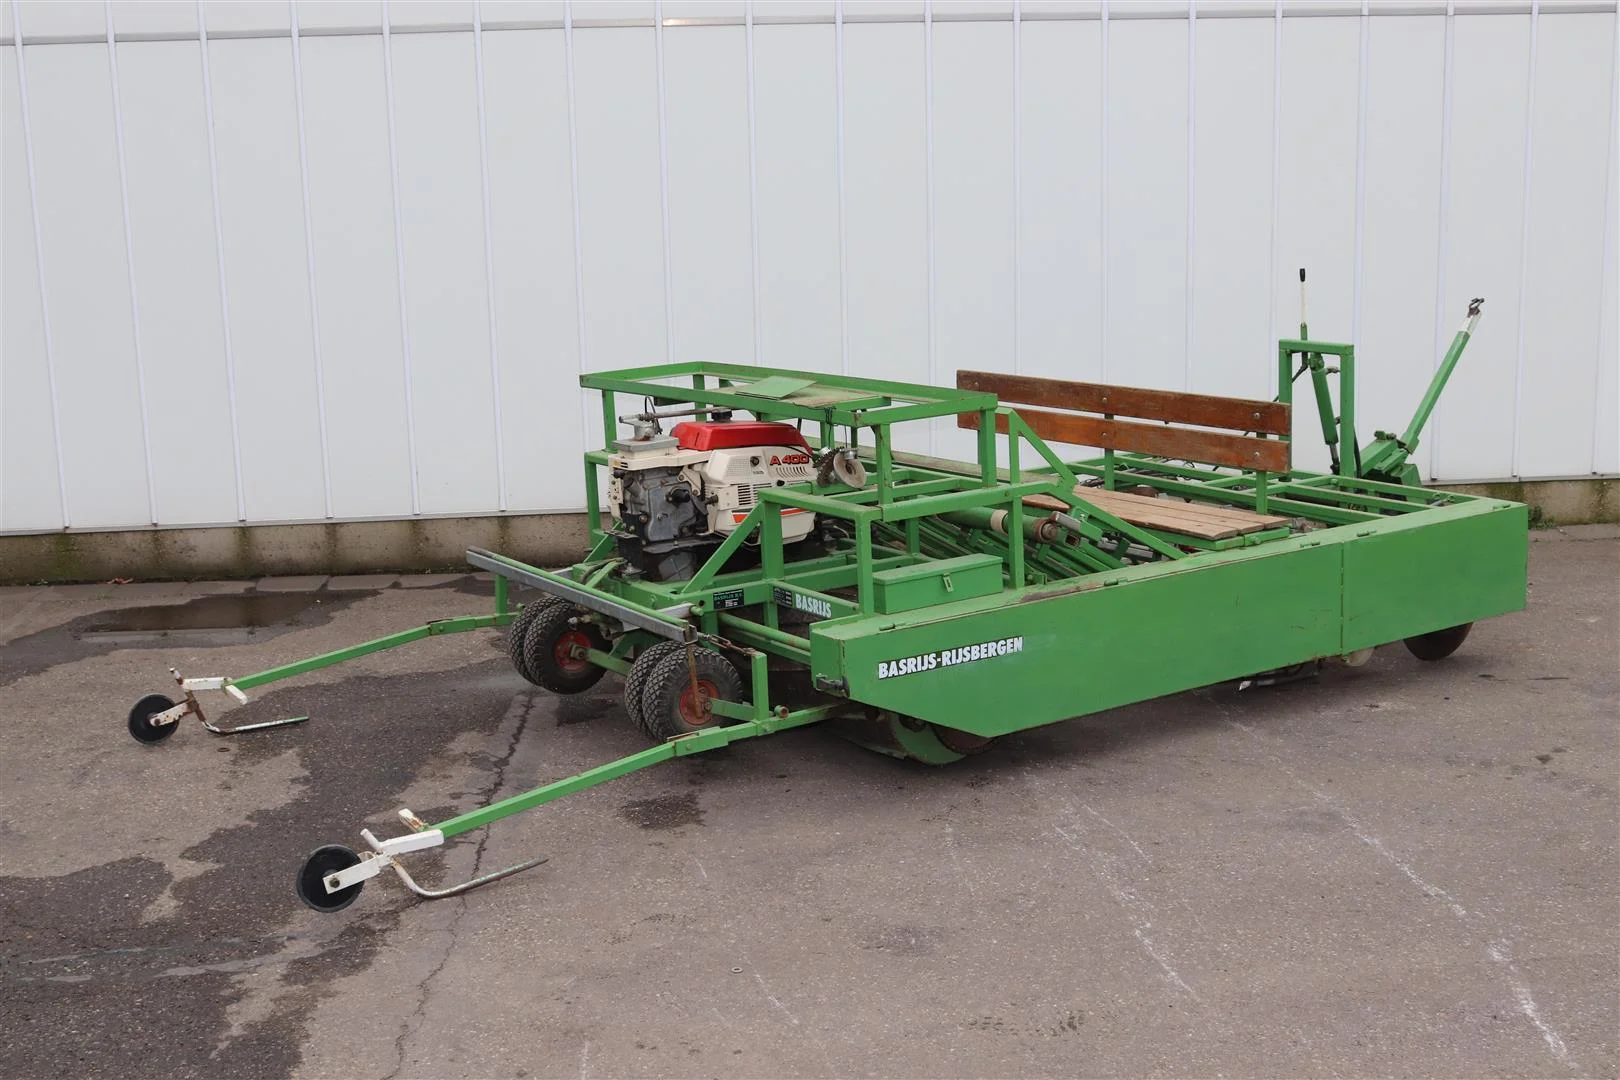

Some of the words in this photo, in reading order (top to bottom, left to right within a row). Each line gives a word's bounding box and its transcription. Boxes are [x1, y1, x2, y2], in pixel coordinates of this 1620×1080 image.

[770, 456, 782, 466] A
[782, 454, 809, 465] 400
[795, 593, 832, 618] BASRIJS
[878, 636, 1023, 679] BASRIJS-RIJSBERGEN
